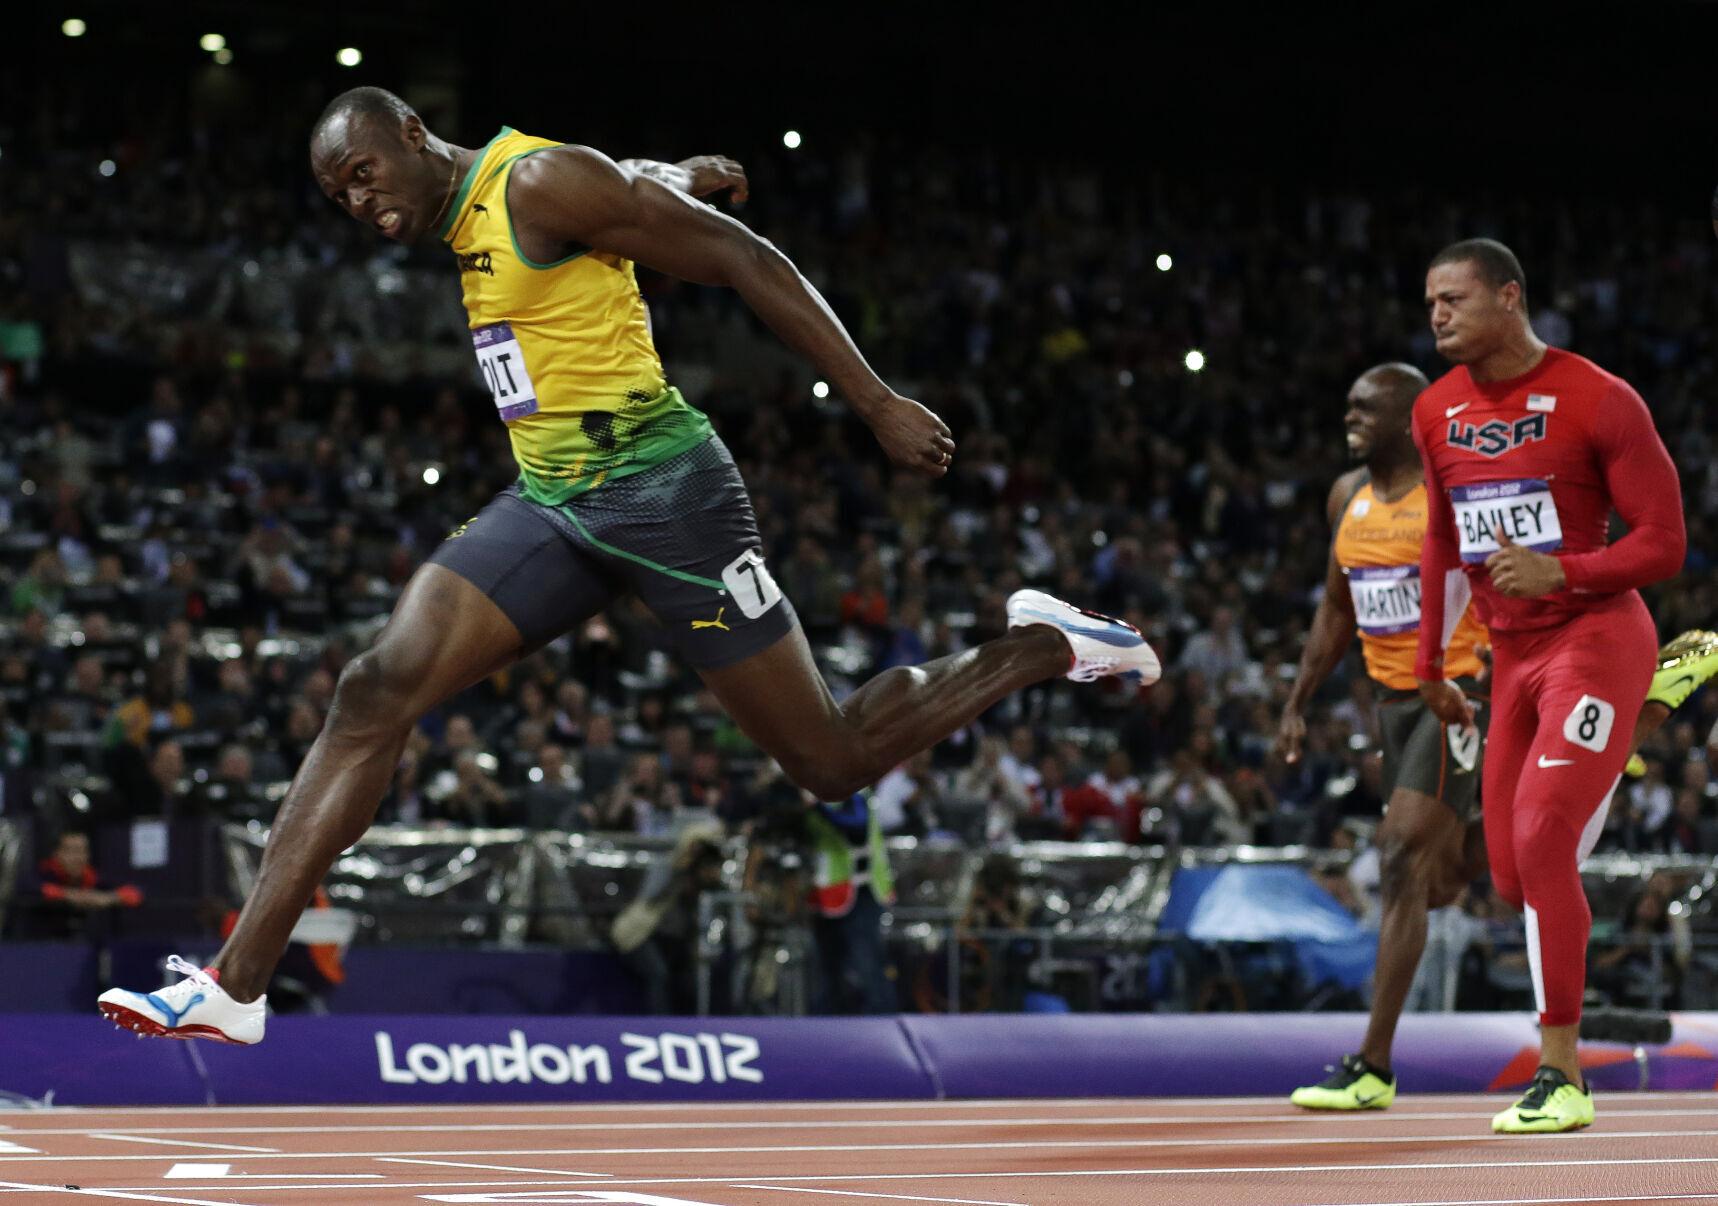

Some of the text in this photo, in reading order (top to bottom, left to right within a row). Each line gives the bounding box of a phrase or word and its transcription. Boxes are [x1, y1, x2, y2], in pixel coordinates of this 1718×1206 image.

[481, 352, 518, 397] OLT
[1447, 413, 1547, 458] USA
[1463, 501, 1542, 544] BAILEY
[735, 557, 767, 607] 7
[1357, 581, 1421, 620] MARTIN
[1578, 703, 1601, 742] 8
[374, 1029, 764, 1085] London 2012
